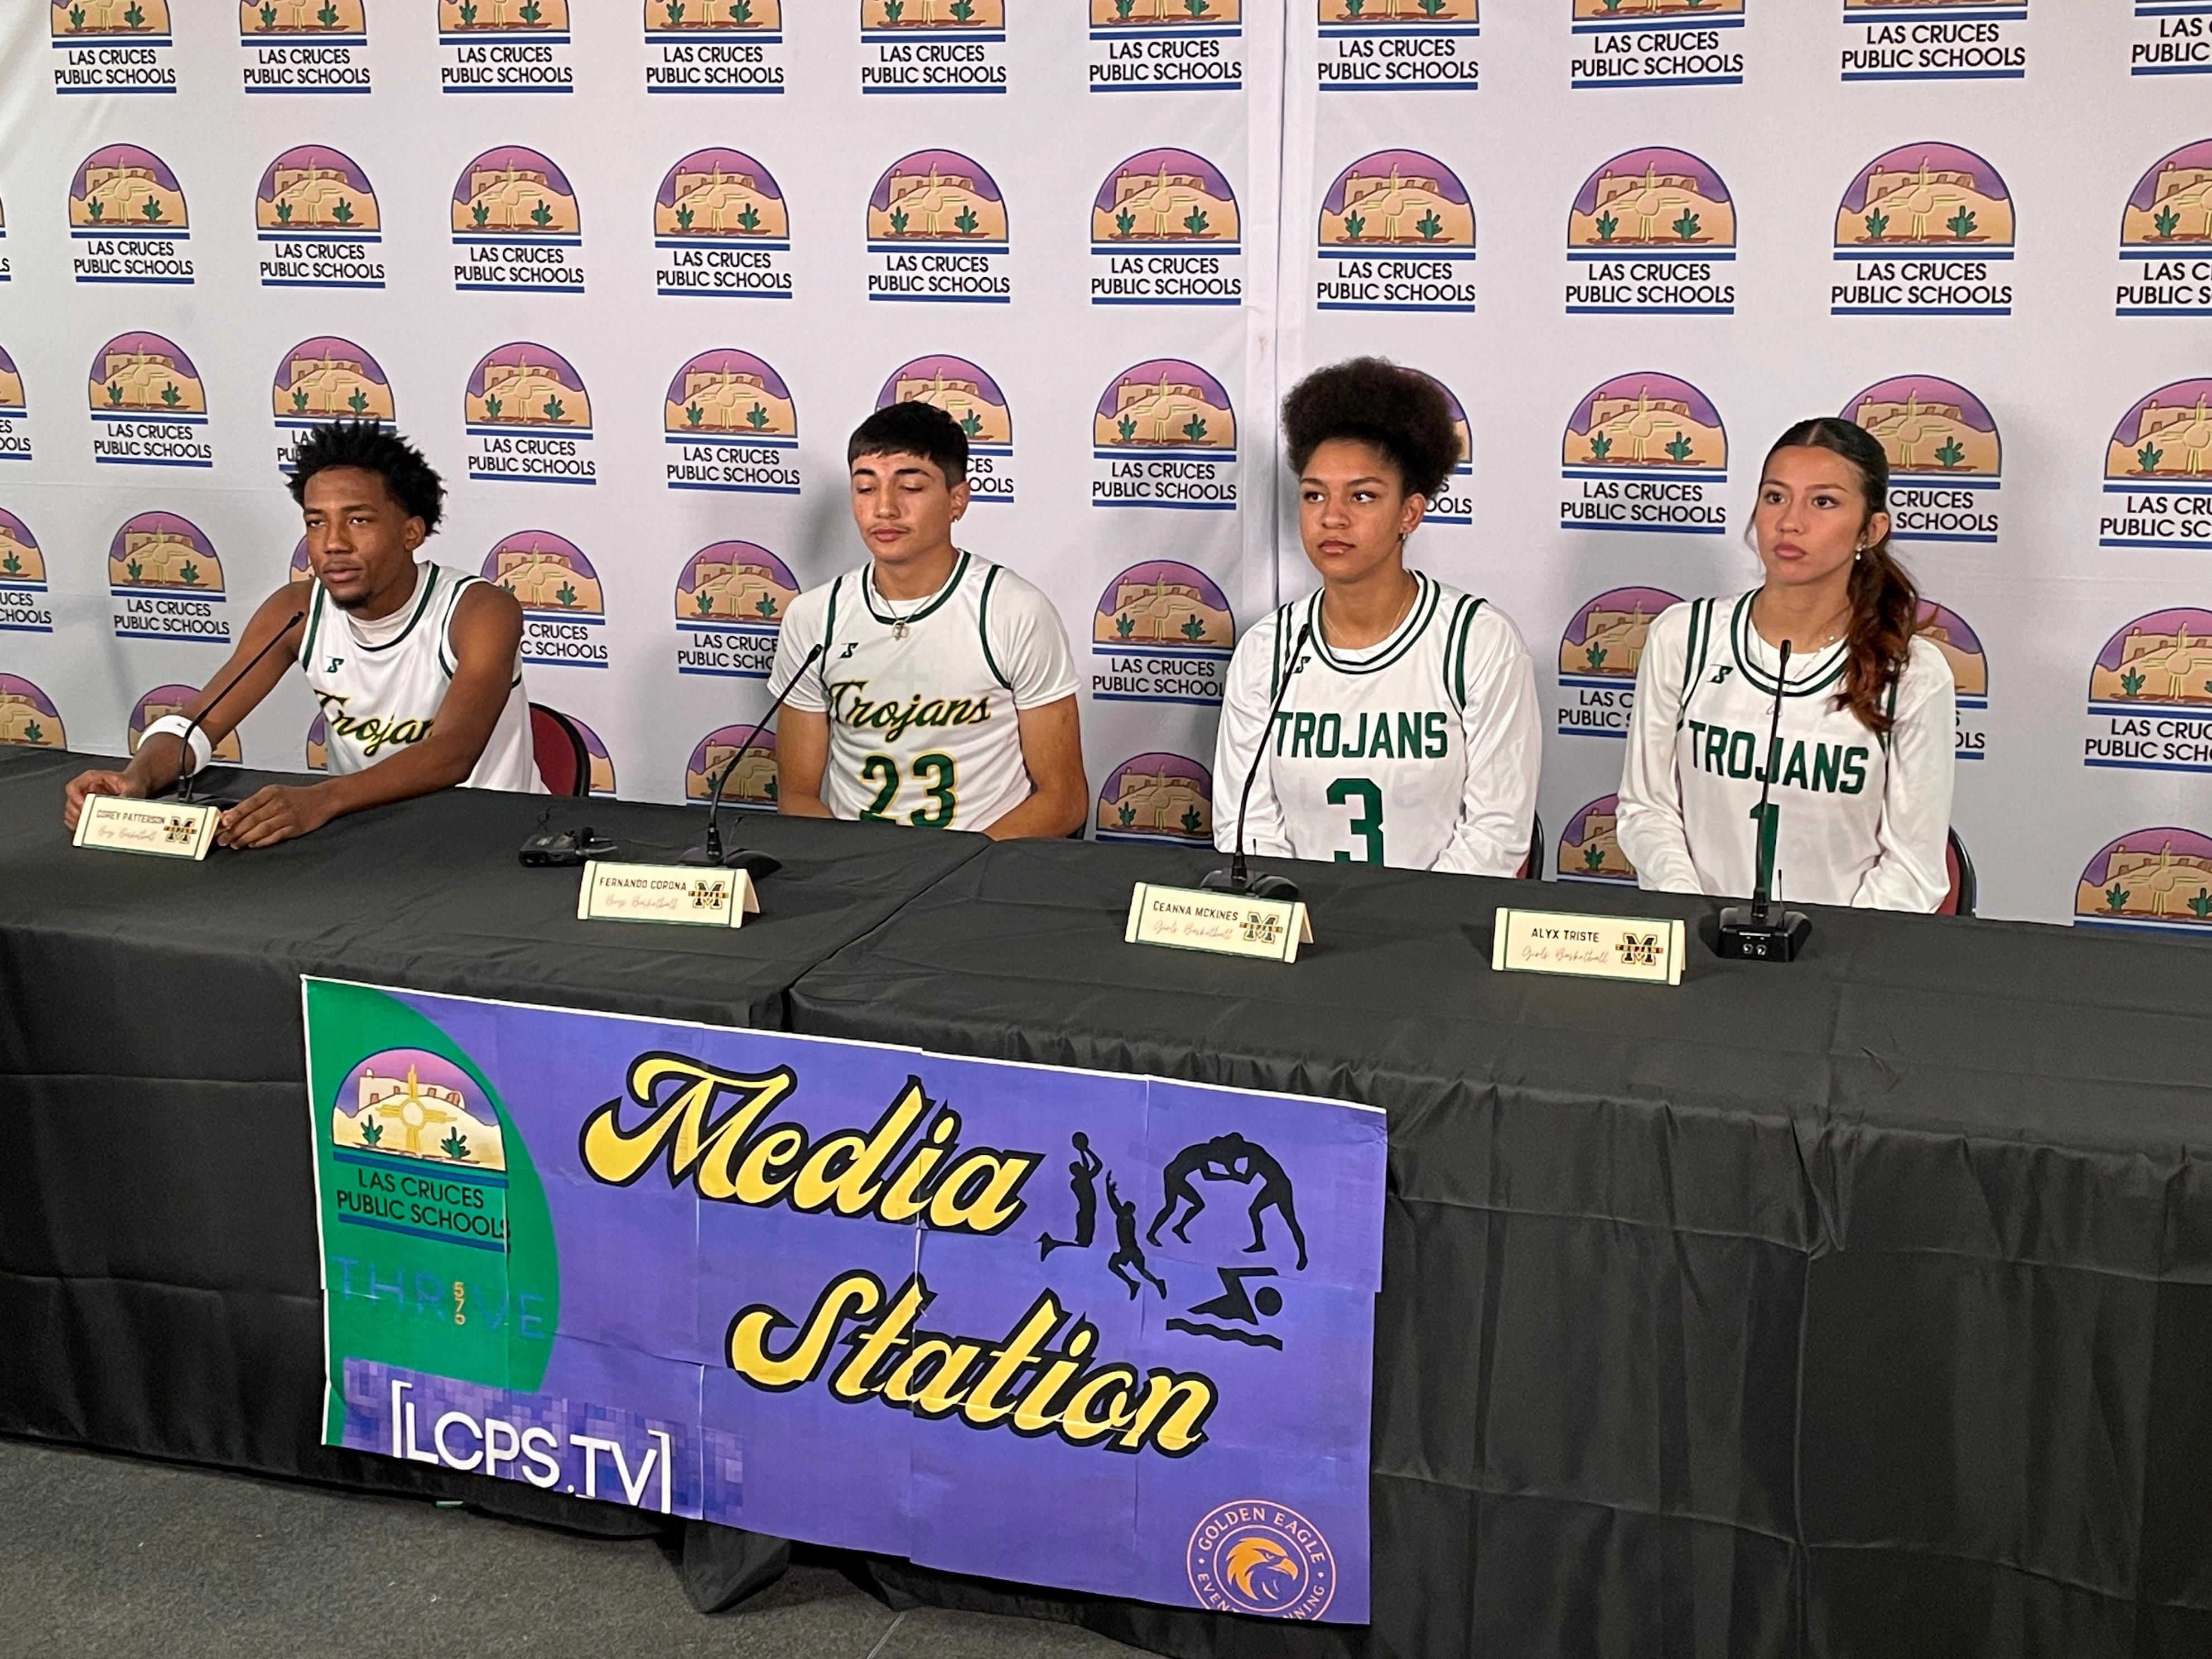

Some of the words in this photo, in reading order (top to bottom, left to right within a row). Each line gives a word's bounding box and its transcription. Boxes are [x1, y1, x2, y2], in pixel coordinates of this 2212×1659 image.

[1867, 26, 1906, 45] LAS
[1911, 24, 1999, 44] CRUCES
[2160, 18, 2203, 38] LAS
[1110, 42, 1143, 60] LAS
[1147, 41, 1220, 59] CRUCES
[1339, 41, 1374, 58] LAS
[1379, 40, 1456, 57] CRUCES
[1594, 35, 1632, 54] LAS
[1637, 32, 1719, 52] CRUCES
[69, 50, 96, 65] LAS
[99, 50, 157, 65] CRUCES
[258, 49, 287, 64] LAS
[290, 49, 350, 64] CRUCES
[663, 47, 693, 62] LAS
[697, 47, 763, 63] CRUCES
[880, 46, 912, 62] LAS
[916, 45, 985, 62] CRUCES
[1842, 49, 1914, 69] PUBLIC
[1919, 47, 2025, 67] SCHOOLS
[2132, 42, 2210, 63] PUBLIC
[646, 67, 701, 84] PUBLIC
[705, 66, 784, 84] SCHOOLS
[862, 66, 919, 84] PUBLIC
[923, 66, 1006, 84] SCHOOLS
[1090, 63, 1149, 81] PUBLIC
[1153, 61, 1242, 80] SCHOOLS
[1318, 62, 1381, 80] PUBLIC
[1385, 61, 1478, 80] SCHOOLS
[1572, 57, 1639, 78] PUBLIC
[1644, 54, 1743, 75] SCHOOLS
[54, 69, 103, 85] PUBLIC
[105, 68, 176, 84] SCHOOLS
[243, 68, 294, 84] PUBLIC
[297, 67, 370, 84] SCHOOLS
[88, 241, 114, 255] LAS
[117, 242, 174, 257] CRUCES
[275, 244, 303, 259] LAS
[305, 244, 365, 260] CRUCES
[470, 247, 499, 262] LAS
[502, 248, 564, 264] CRUCES
[74, 258, 122, 274] PUBLIC
[124, 259, 194, 275] SCHOOLS
[259, 262, 310, 277] PUBLIC
[312, 262, 385, 279] SCHOOLS
[886, 255, 917, 272] LAS
[922, 256, 989, 273] CRUCES
[1111, 258, 1143, 274] LAS
[1148, 258, 1219, 274] CRUCES
[1338, 262, 1372, 279] LAS
[1377, 263, 1452, 280] CRUCES
[1589, 264, 1625, 281] LAS
[1630, 264, 1710, 281] CRUCES
[1857, 264, 1895, 281] LAS
[1901, 263, 1987, 281] CRUCES
[2143, 263, 2185, 281] LAS
[454, 266, 506, 282] PUBLIC
[509, 267, 584, 284] SCHOOLS
[868, 275, 924, 292] PUBLIC
[928, 276, 1010, 293] SCHOOLS
[1091, 278, 1150, 295] PUBLIC
[1154, 278, 1241, 295] SCHOOLS
[1317, 282, 1380, 300] PUBLIC
[1384, 283, 1476, 302] SCHOOLS
[1565, 285, 1632, 303] PUBLIC
[1636, 286, 1734, 303] SCHOOLS
[1832, 286, 1903, 304] PUBLIC
[1907, 286, 2012, 304] SCHOOLS
[2116, 286, 2193, 305] PUBLIC
[107, 423, 134, 438] LAS
[136, 425, 193, 440] CRUCES
[94, 440, 141, 456] PUBLIC
[143, 442, 212, 459] SCHOOLS
[484, 438, 512, 454] LAS
[515, 440, 576, 456] CRUCES
[683, 447, 712, 462] LAS
[716, 448, 780, 465] CRUCES
[468, 456, 519, 472] PUBLIC
[522, 458, 596, 476] SCHOOLS
[667, 464, 720, 481] PUBLIC
[723, 466, 800, 485] SCHOOLS
[1112, 462, 1143, 479] LAS
[1148, 463, 1215, 480] CRUCES
[1092, 481, 1151, 498] PUBLIC
[1155, 481, 1237, 500] SCHOOLS
[1584, 482, 1619, 499] LAS
[1624, 484, 1703, 502] CRUCES
[1889, 490, 1973, 509] CRUCES
[1561, 501, 1627, 520] PUBLIC
[1630, 504, 1726, 524] SCHOOLS
[2127, 496, 2168, 514] LAS
[1896, 512, 1998, 532] SCHOOLS
[2100, 518, 2175, 537] PUBLIC
[127, 599, 153, 614] LAS
[156, 601, 211, 617] CRUCES
[113, 615, 160, 631] PUBLIC
[163, 618, 230, 635] SCHOOLS
[528, 624, 588, 640] CRUCES
[536, 641, 608, 659] SCHOOLS
[694, 634, 722, 649] LAS
[678, 650, 730, 668] PUBLIC
[1111, 658, 1143, 674] LAS
[1146, 659, 1215, 677] CRUCES
[1092, 676, 1150, 693] PUBLIC
[1154, 679, 1225, 697] SCHOOL
[1580, 690, 1614, 707] LAS
[828, 679, 991, 743] Trojans
[1558, 708, 1622, 728] PUBLIC
[1274, 711, 1448, 759] TROJANS
[2110, 719, 2151, 737] LAS
[1688, 719, 1869, 795] TROJANS
[2085, 739, 2158, 759] PUBLIC
[859, 750, 958, 829] 23
[1326, 777, 1384, 869] 3
[599, 876, 648, 889] FERNANDO
[650, 880, 687, 891] CORONA
[1153, 900, 1192, 916] CEANNA
[1194, 907, 1239, 921] MCKINES
[1531, 928, 1560, 939] ALYX
[1563, 929, 1599, 943] TRISTE
[580, 1050, 1045, 1236] Media
[358, 1168, 396, 1192] LAS
[401, 1176, 483, 1209] CRUCES
[336, 1189, 405, 1219] PUBLIC
[410, 1203, 510, 1239] SCHOOLS
[725, 1270, 1219, 1459] Station
[1198, 1507, 1266, 1551] GOLDEN
[1273, 1511, 1326, 1564] EAGLE
